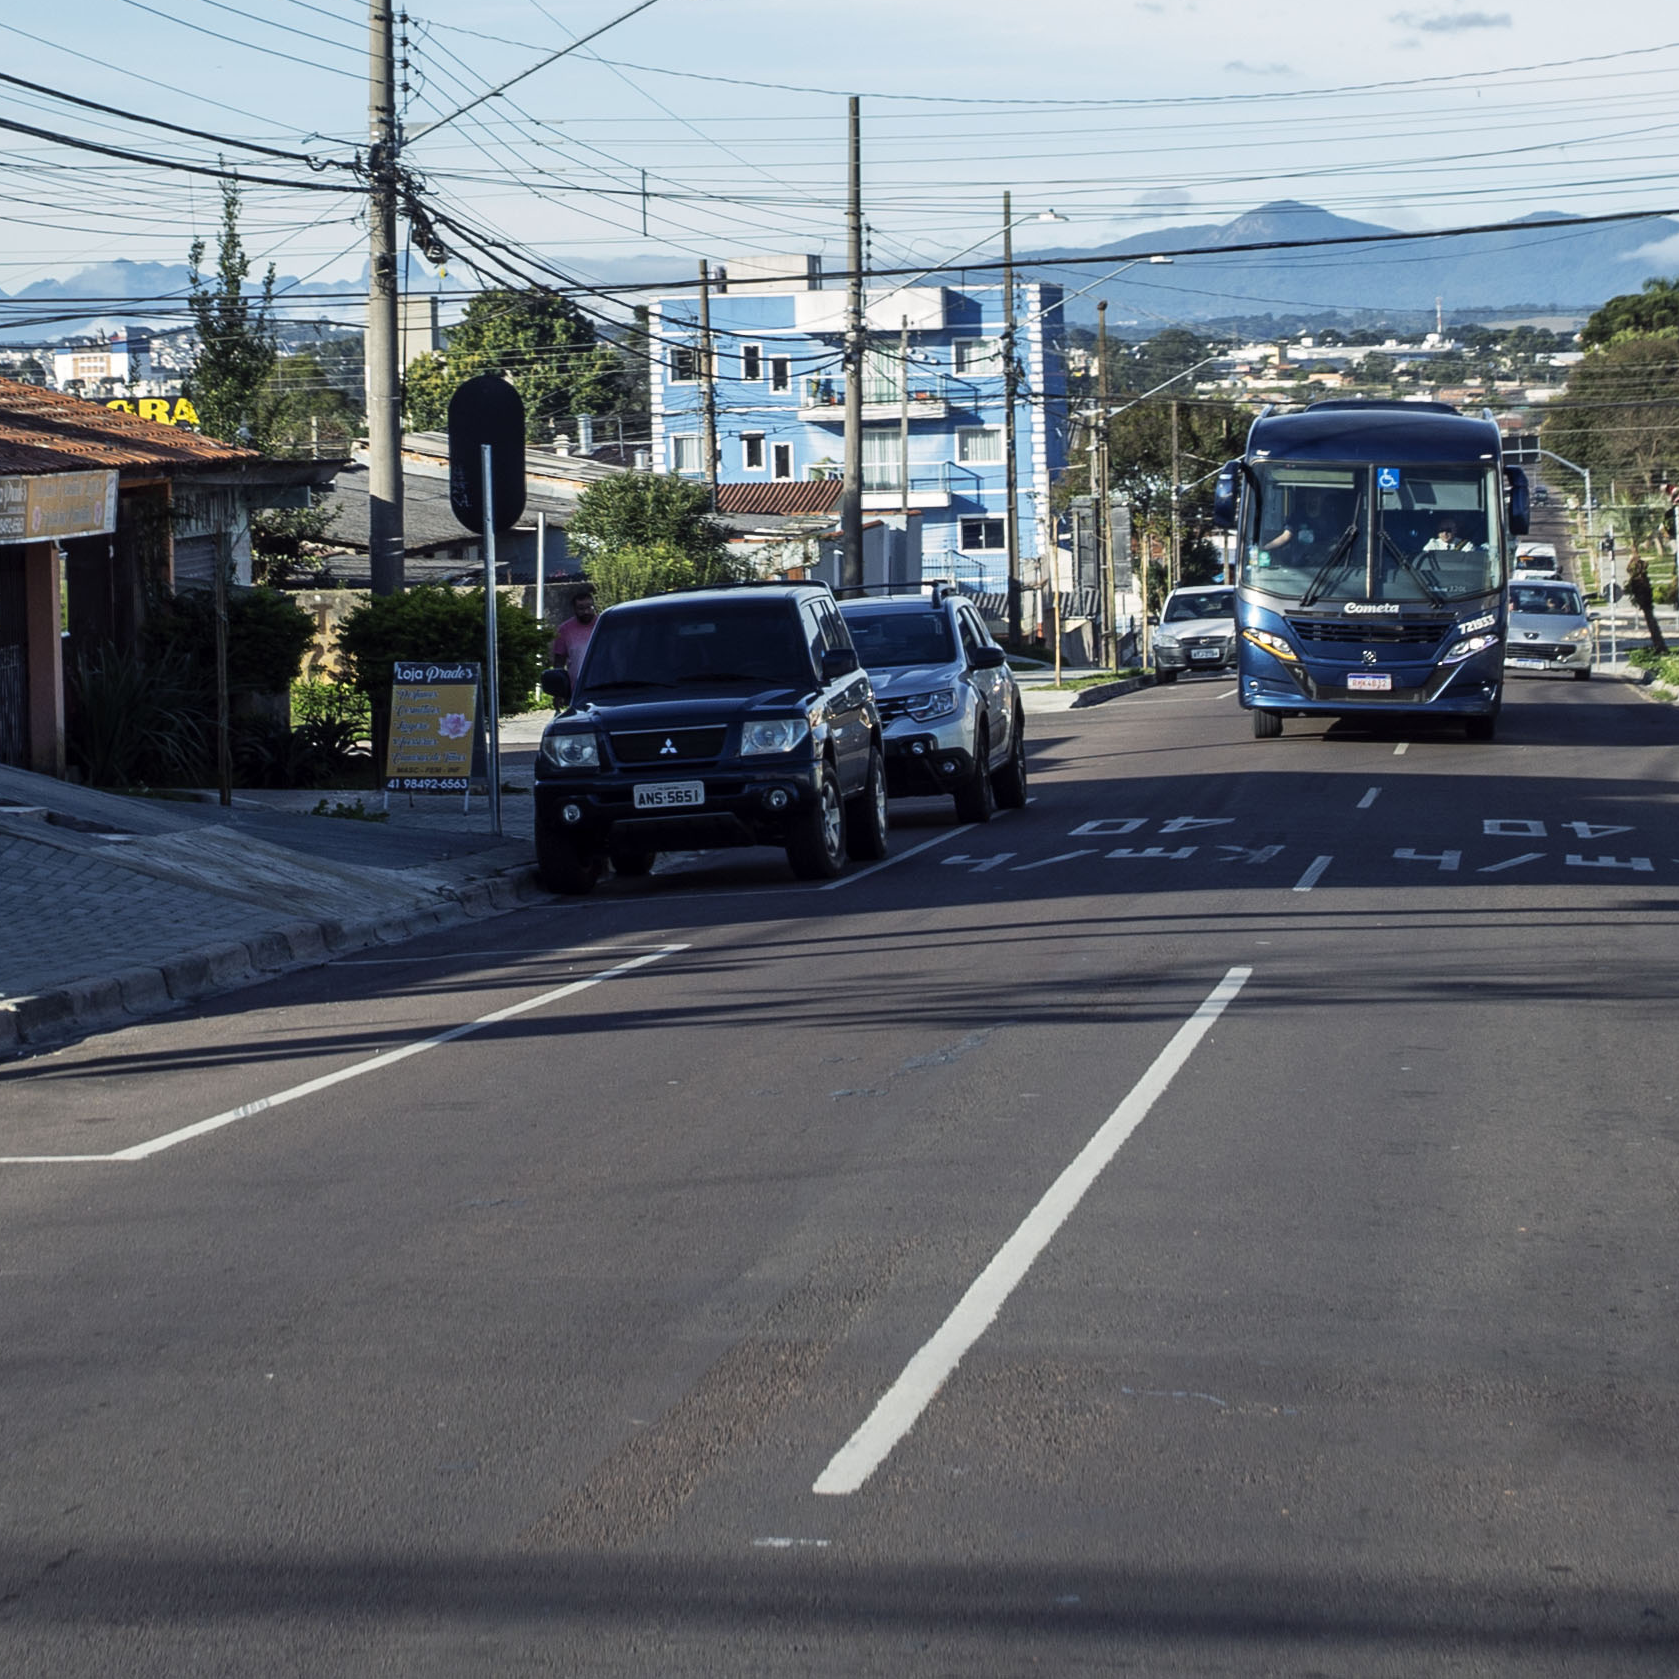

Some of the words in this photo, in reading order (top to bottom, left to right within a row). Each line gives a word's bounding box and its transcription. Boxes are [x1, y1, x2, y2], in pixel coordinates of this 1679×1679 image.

[1344, 602, 1400, 614] Cometa
[397, 667, 423, 682] Loja
[388, 779, 399, 789] 41
[1482, 818, 1636, 839] 40
